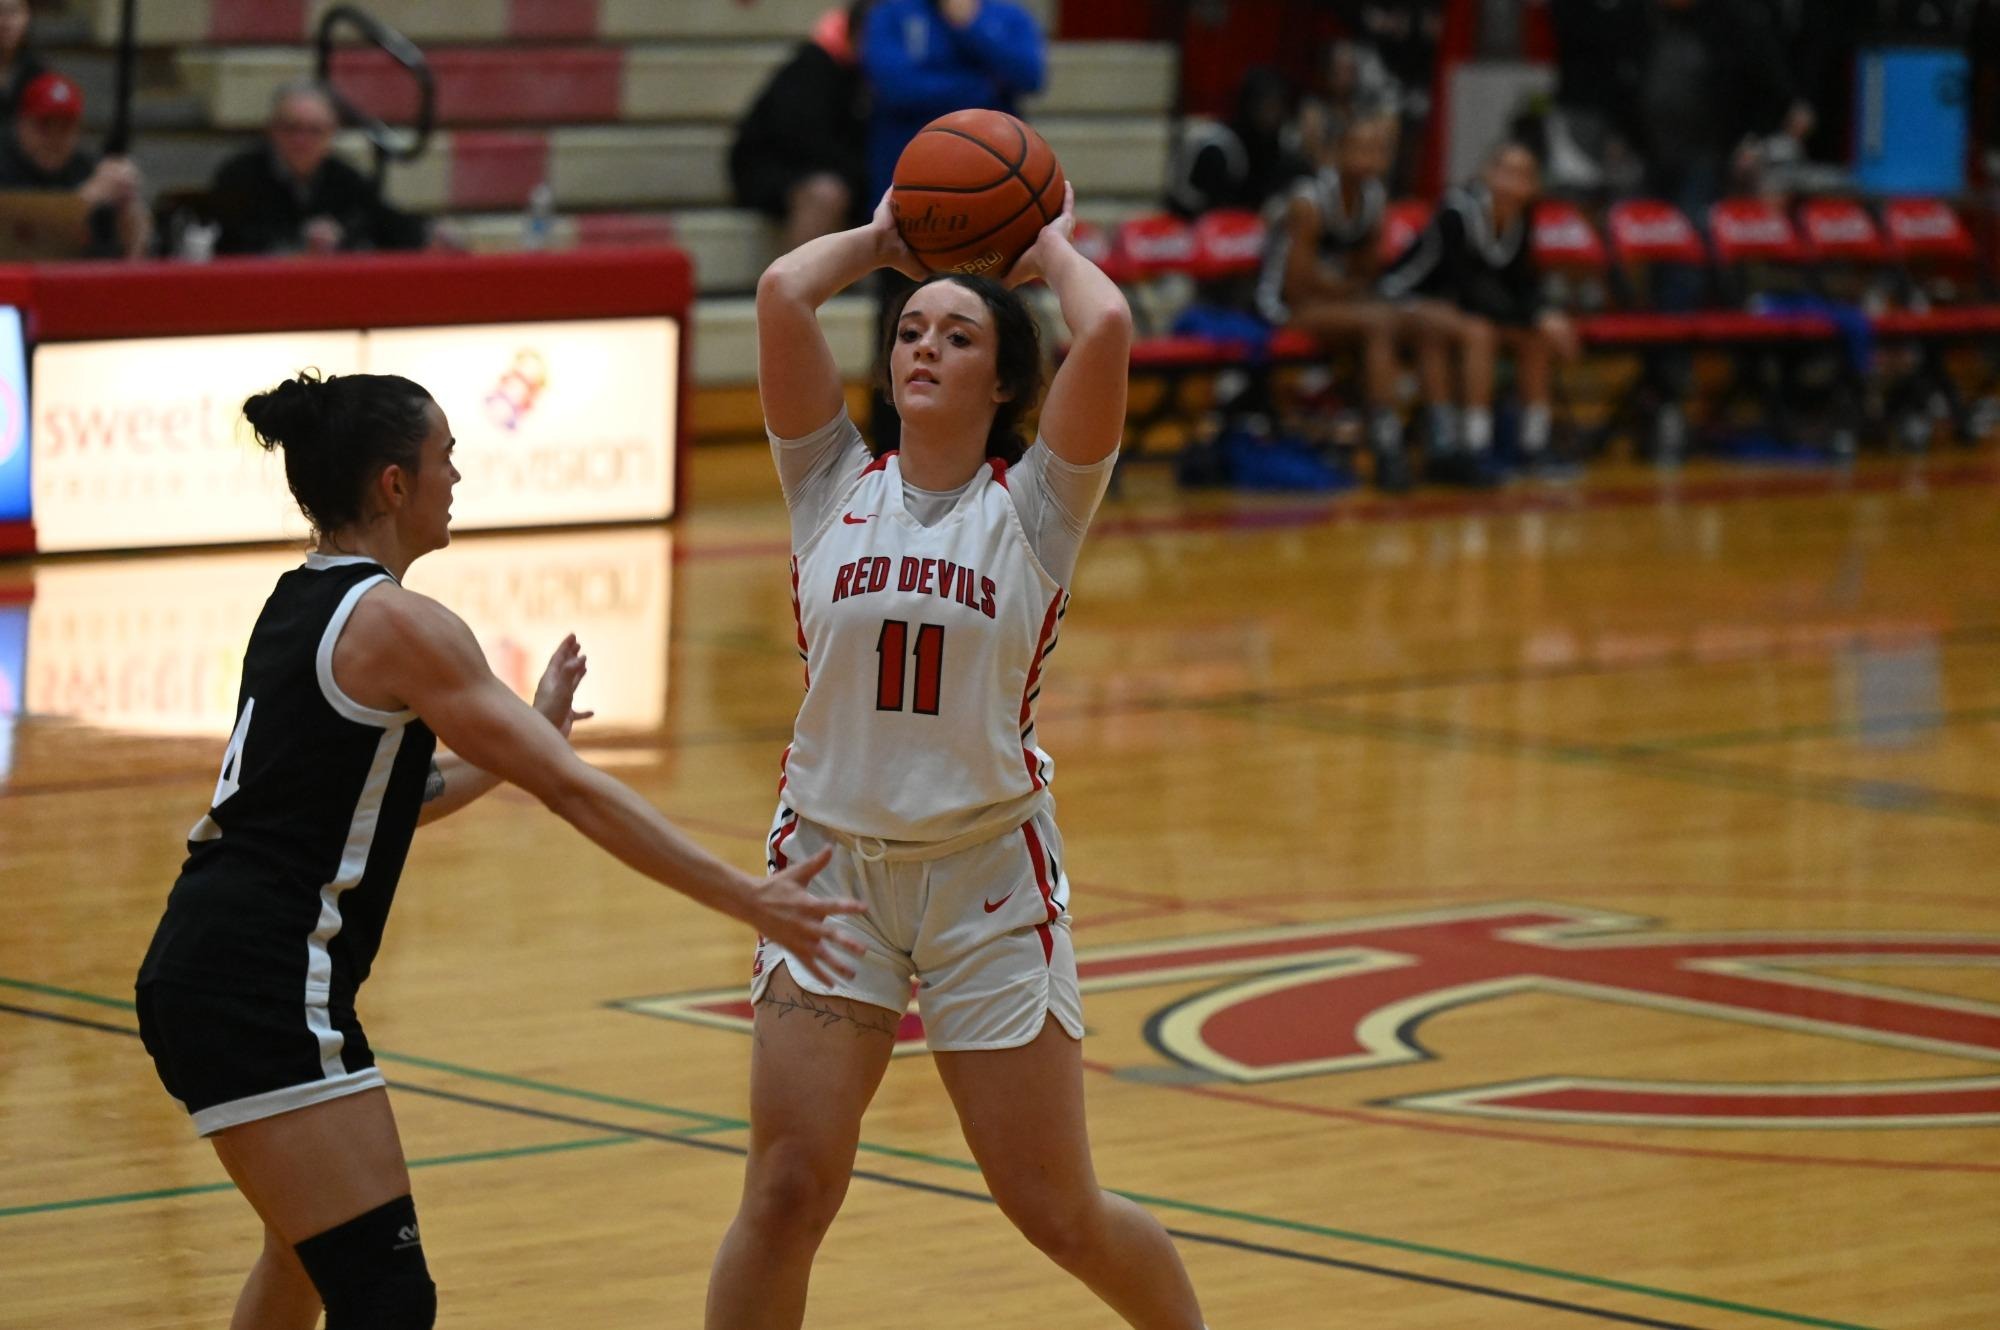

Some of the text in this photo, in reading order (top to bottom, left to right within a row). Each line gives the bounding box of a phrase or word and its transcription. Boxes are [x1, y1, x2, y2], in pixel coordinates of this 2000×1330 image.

[832, 556, 996, 619] RED DEVILS
[876, 619, 945, 716] 11
